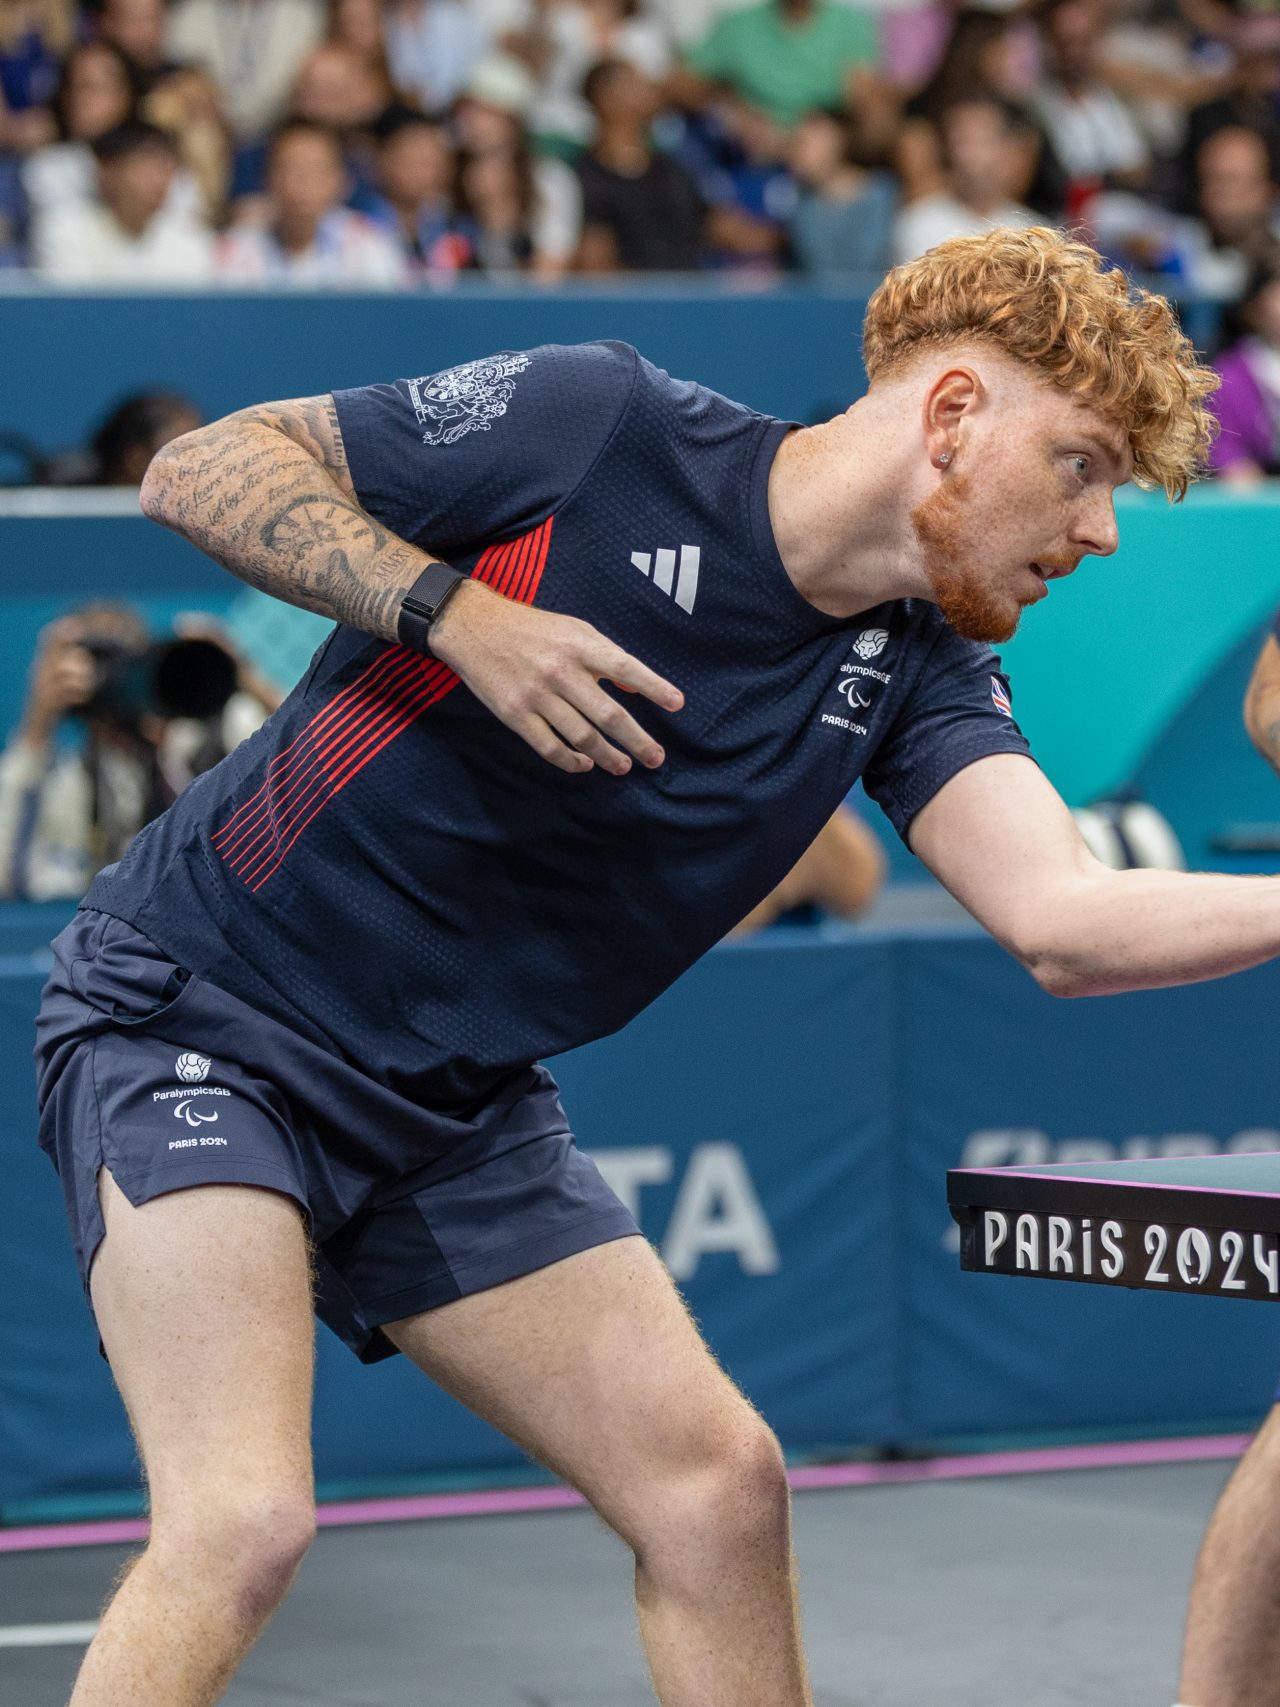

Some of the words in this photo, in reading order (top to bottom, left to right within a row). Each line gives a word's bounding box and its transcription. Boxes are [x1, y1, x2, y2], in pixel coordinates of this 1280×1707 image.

[821, 713, 850, 729] PARIS
[153, 1087, 231, 1102] ParalympicsGB
[168, 1138, 198, 1150] PARIS
[199, 1137, 228, 1146] 2024
[1144, 1224, 1279, 1293] 2024
